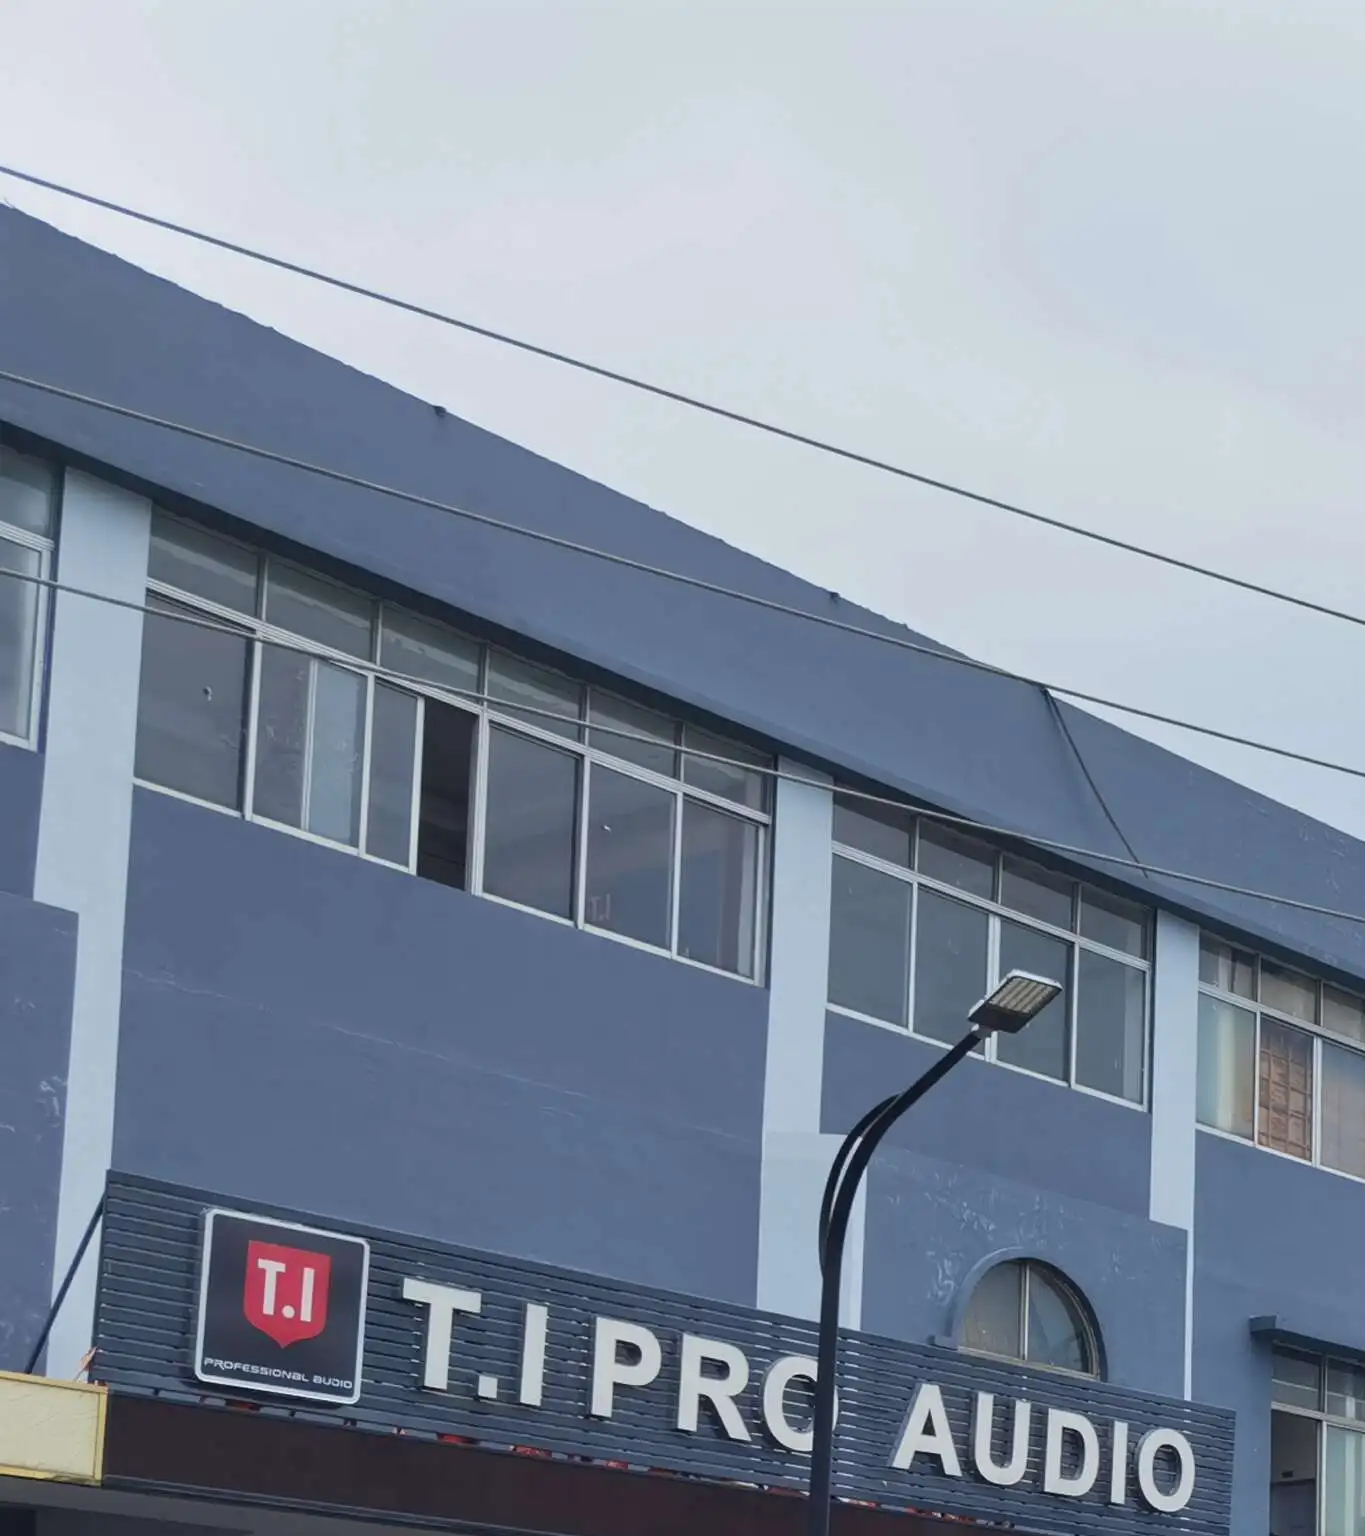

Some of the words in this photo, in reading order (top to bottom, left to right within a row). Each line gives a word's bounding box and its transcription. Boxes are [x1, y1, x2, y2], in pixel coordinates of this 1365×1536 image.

[256, 1257, 316, 1323] T.I
[203, 1356, 309, 1382] PROFESSIONAL
[312, 1374, 353, 1389] AUDIO
[401, 1276, 549, 1407] T.I
[589, 1315, 839, 1452] PRO
[891, 1382, 1196, 1513] AUDIO
